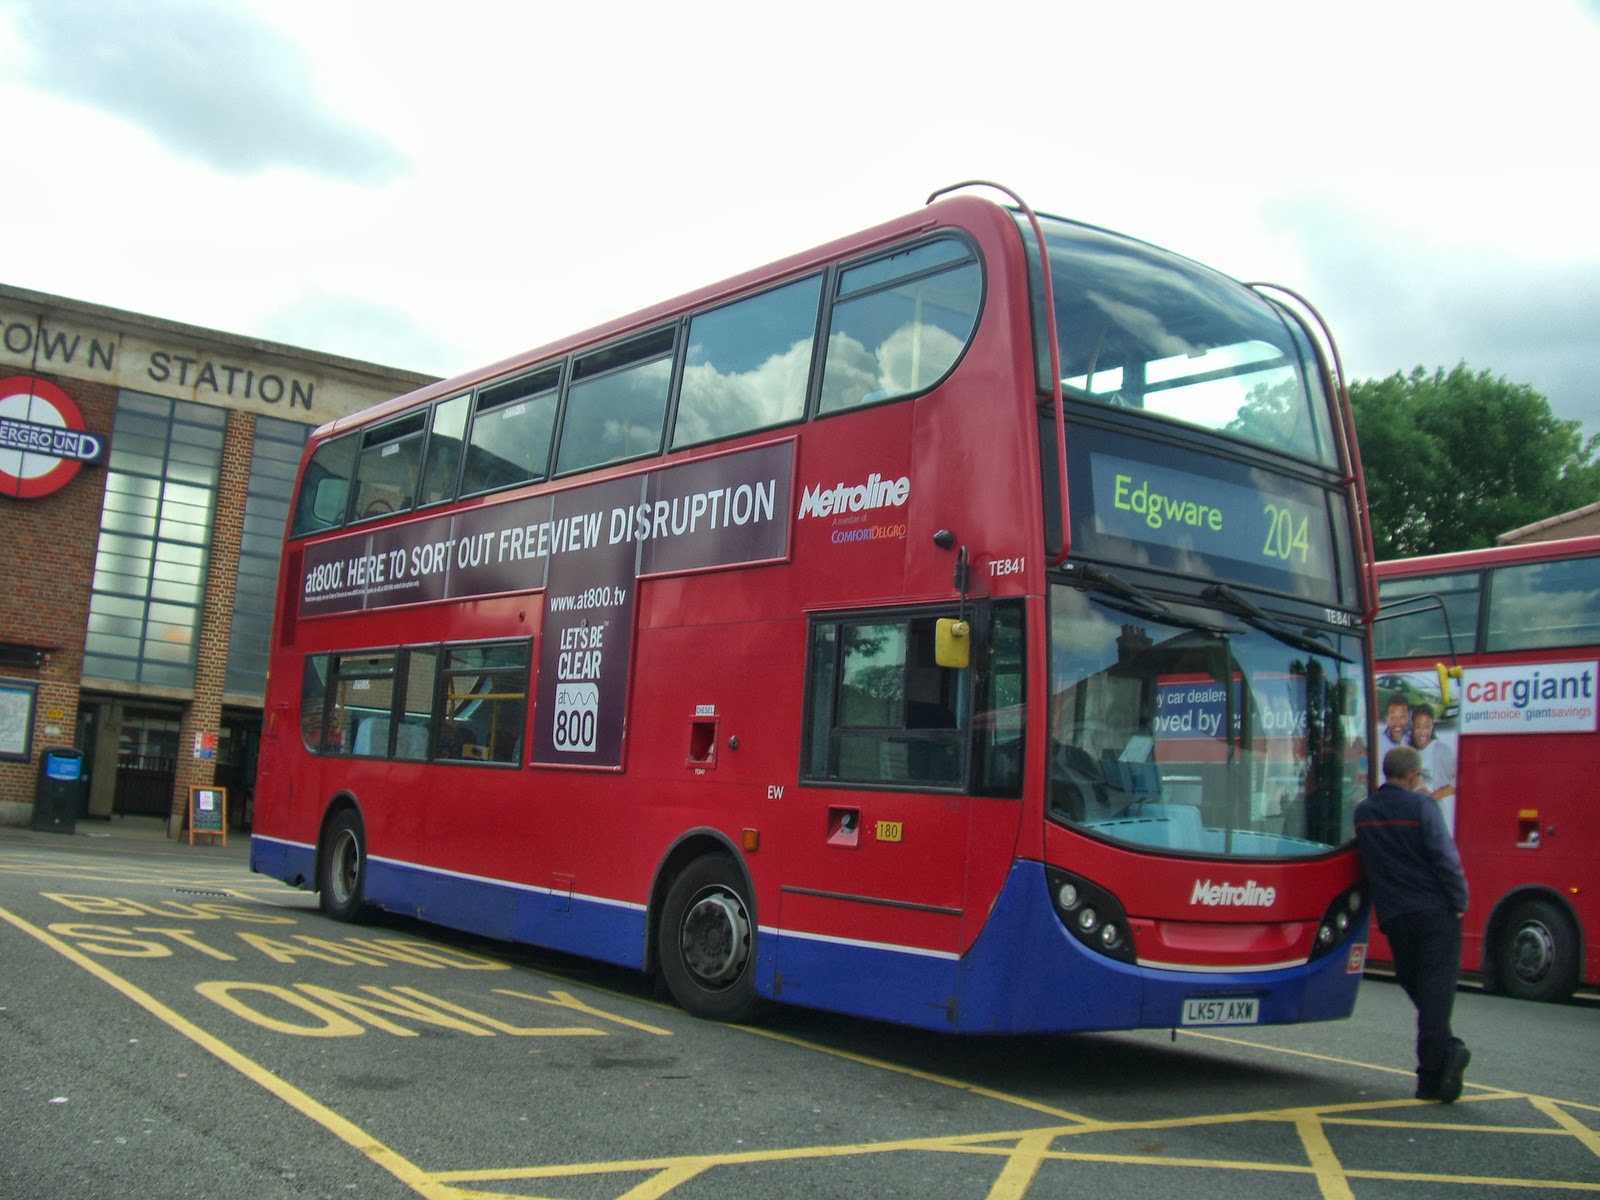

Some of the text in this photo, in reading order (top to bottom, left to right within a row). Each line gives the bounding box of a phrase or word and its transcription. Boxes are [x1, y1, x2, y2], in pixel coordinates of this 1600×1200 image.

[0, 321, 314, 411] OWN STATION
[798, 473, 911, 520] Metroline
[346, 553, 386, 587] HERE
[389, 549, 406, 580] TO
[410, 540, 455, 577] SORT
[457, 532, 495, 569] OUT
[498, 511, 603, 562] FREEVIEW
[609, 479, 776, 545] DISRUPTION
[1114, 474, 1310, 564] Edgware 204
[989, 557, 1025, 577] TE841
[550, 586, 626, 612] www.at800.tv
[1325, 608, 1351, 627] TE841
[560, 626, 589, 650] LET'S
[589, 625, 604, 648] BE
[557, 650, 602, 680] CLEAR
[1167, 692, 1185, 704] car
[1466, 669, 1593, 709] cargiant
[696, 706, 713, 714] DIESEL
[1198, 708, 1222, 737] by
[1465, 706, 1592, 723] giantchoice giantsavings
[555, 709, 595, 747] 800
[767, 785, 784, 800] EW
[880, 824, 898, 839] 180
[1190, 879, 1276, 907] Metroline
[39, 892, 297, 925] BUS
[194, 981, 674, 1038] ONLY
[1188, 1001, 1253, 1020] LK57 AXW
